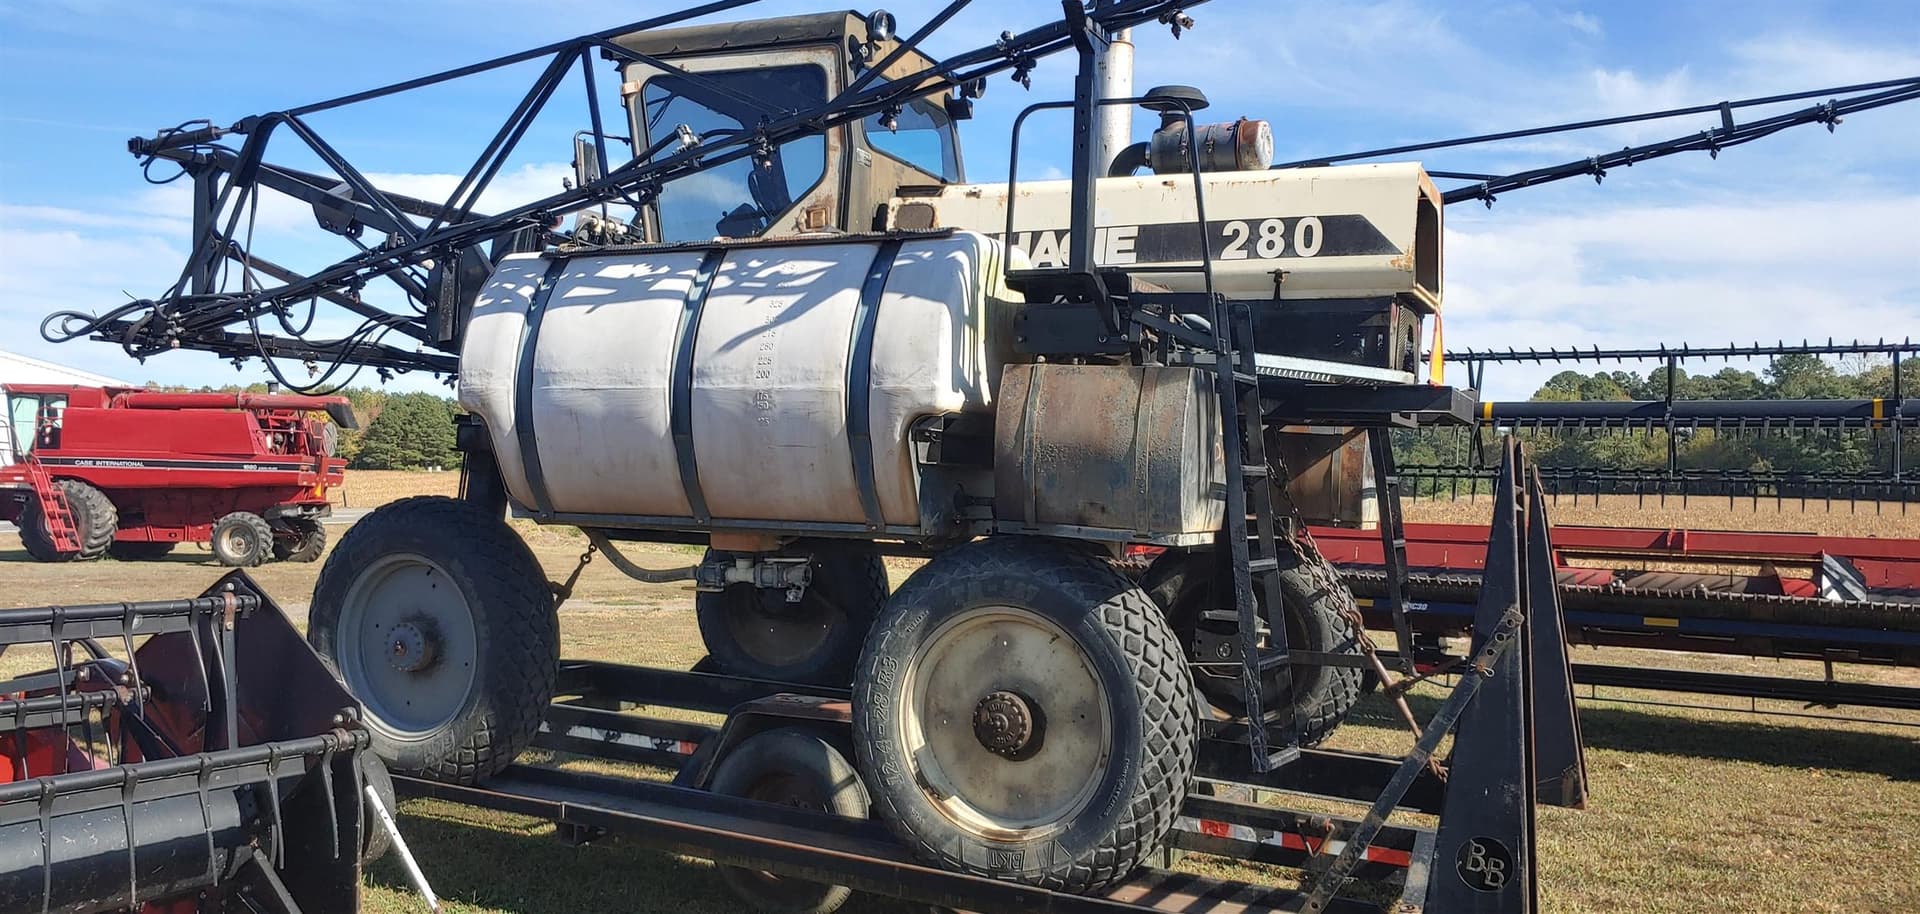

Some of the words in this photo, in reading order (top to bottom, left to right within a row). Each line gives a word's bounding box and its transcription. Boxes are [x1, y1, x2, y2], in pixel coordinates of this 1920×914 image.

[1220, 216, 1323, 260] 280
[756, 369, 770, 378] 200
[95, 460, 144, 468] INTERNATIONAL
[990, 850, 1022, 870] BKT
